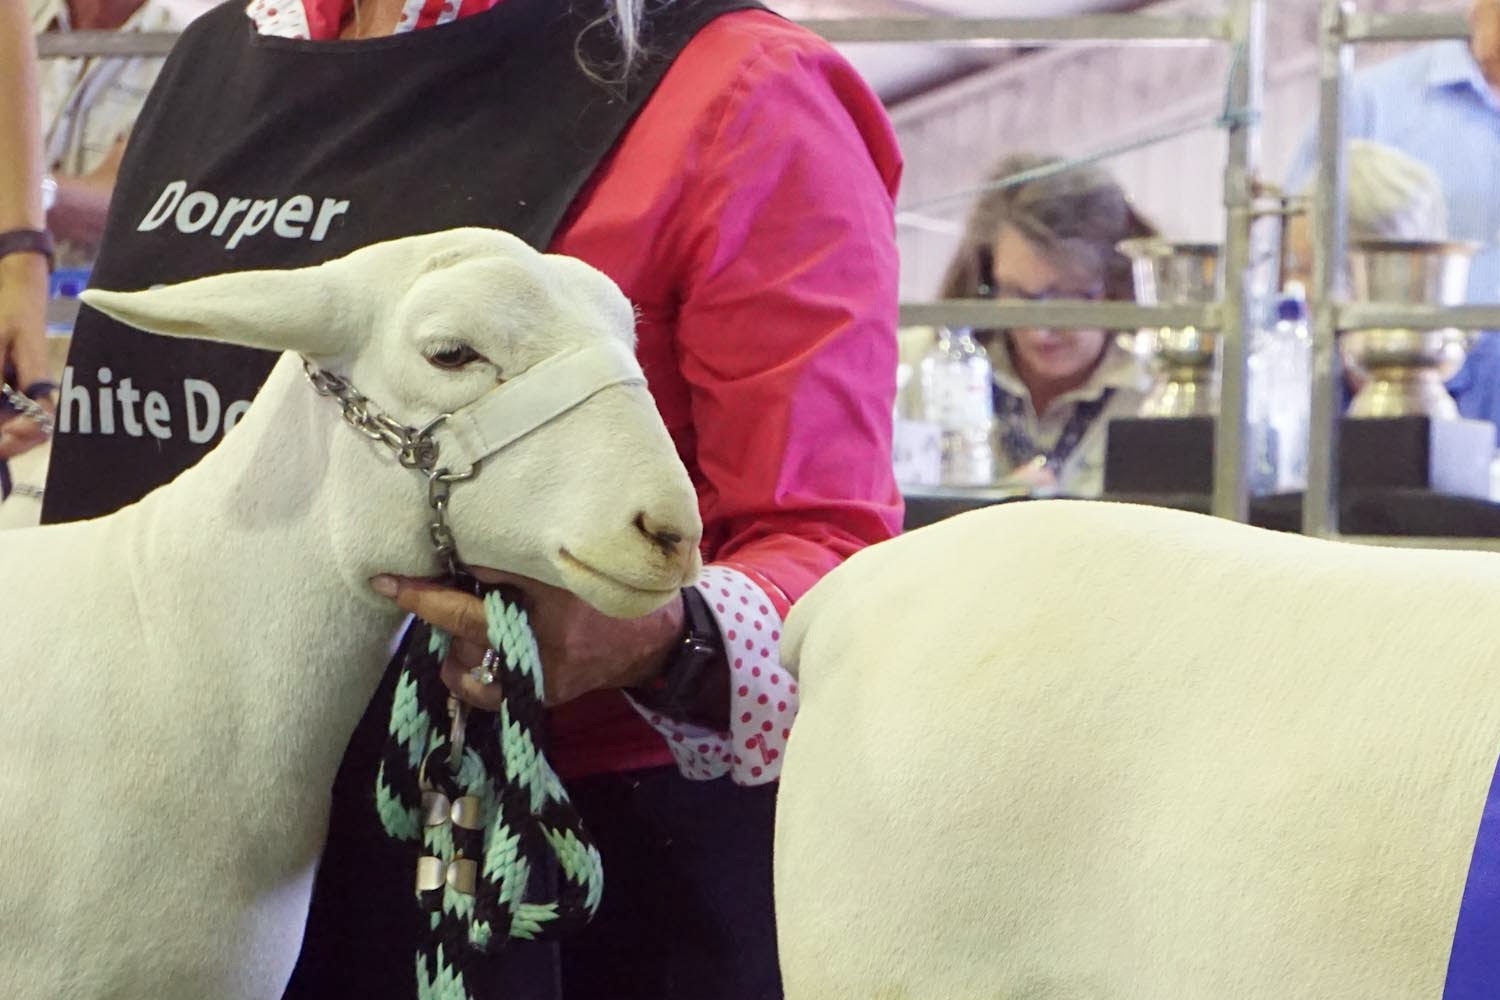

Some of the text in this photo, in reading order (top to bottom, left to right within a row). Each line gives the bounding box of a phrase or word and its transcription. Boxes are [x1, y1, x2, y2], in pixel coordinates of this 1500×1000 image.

[137, 180, 350, 250] Dorper
[58, 365, 253, 444] hite Do
